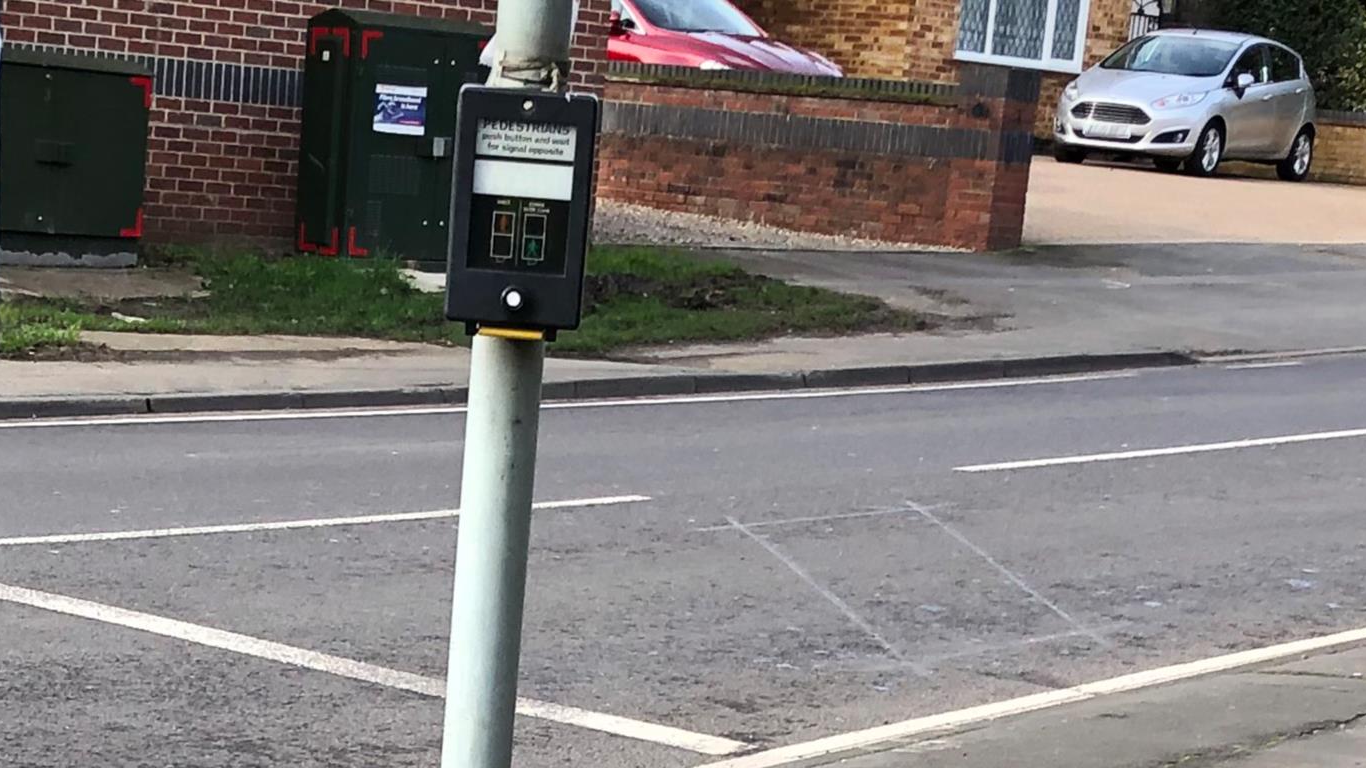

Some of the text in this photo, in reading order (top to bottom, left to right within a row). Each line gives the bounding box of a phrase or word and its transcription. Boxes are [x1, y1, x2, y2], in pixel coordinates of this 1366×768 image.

[483, 119, 570, 135] PEDESTRIANS
[504, 133, 532, 143] button
[535, 136, 550, 144] and
[502, 144, 527, 153] signal
[529, 147, 563, 156] opposite
